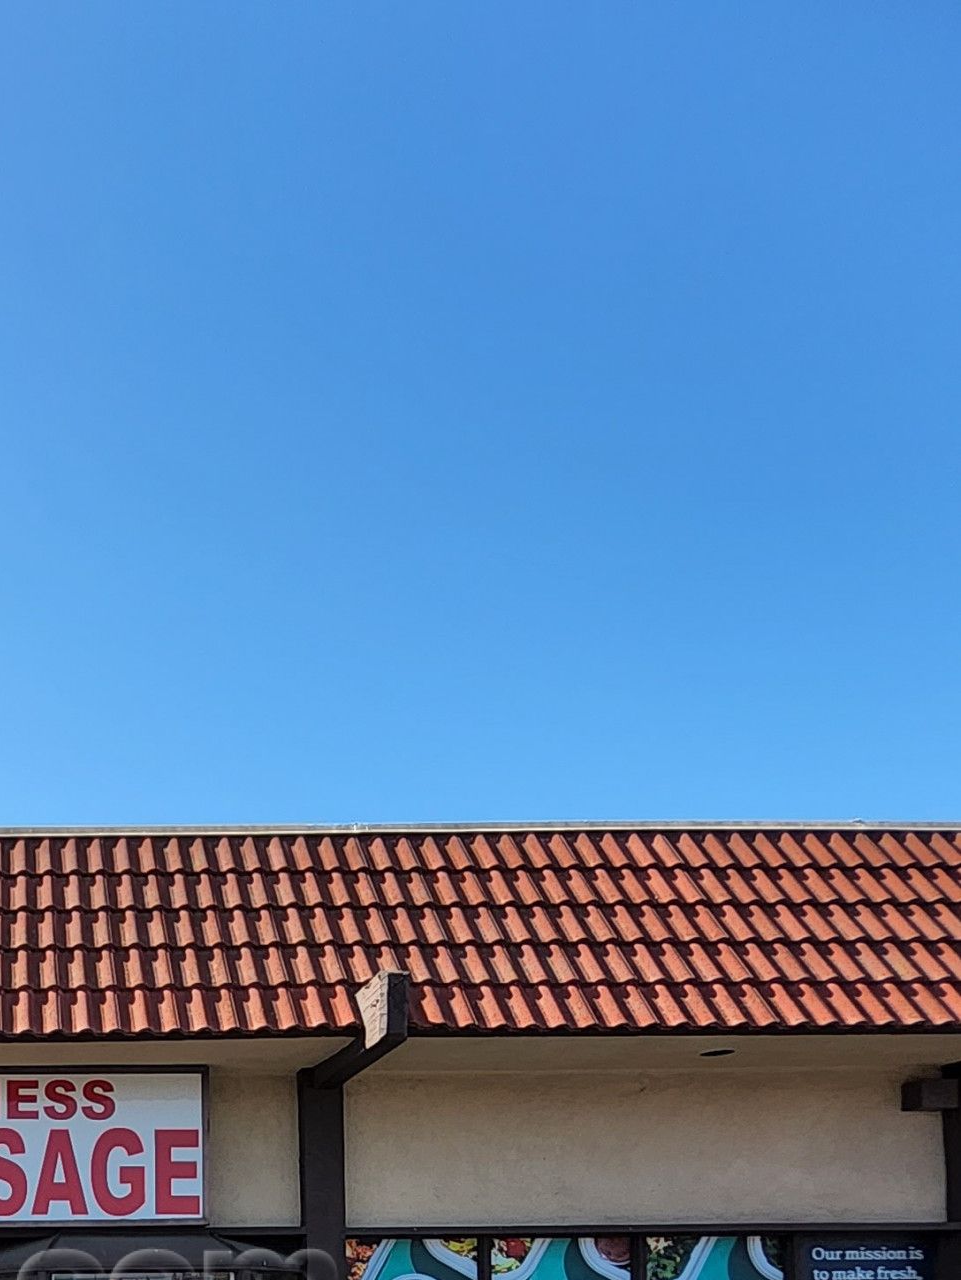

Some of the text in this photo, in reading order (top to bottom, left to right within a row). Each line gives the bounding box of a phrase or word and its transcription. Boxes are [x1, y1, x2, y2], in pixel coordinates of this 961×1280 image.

[812, 1247, 925, 1260] Our mission is
[813, 1268, 829, 1280] to
[832, 1267, 874, 1280] make
